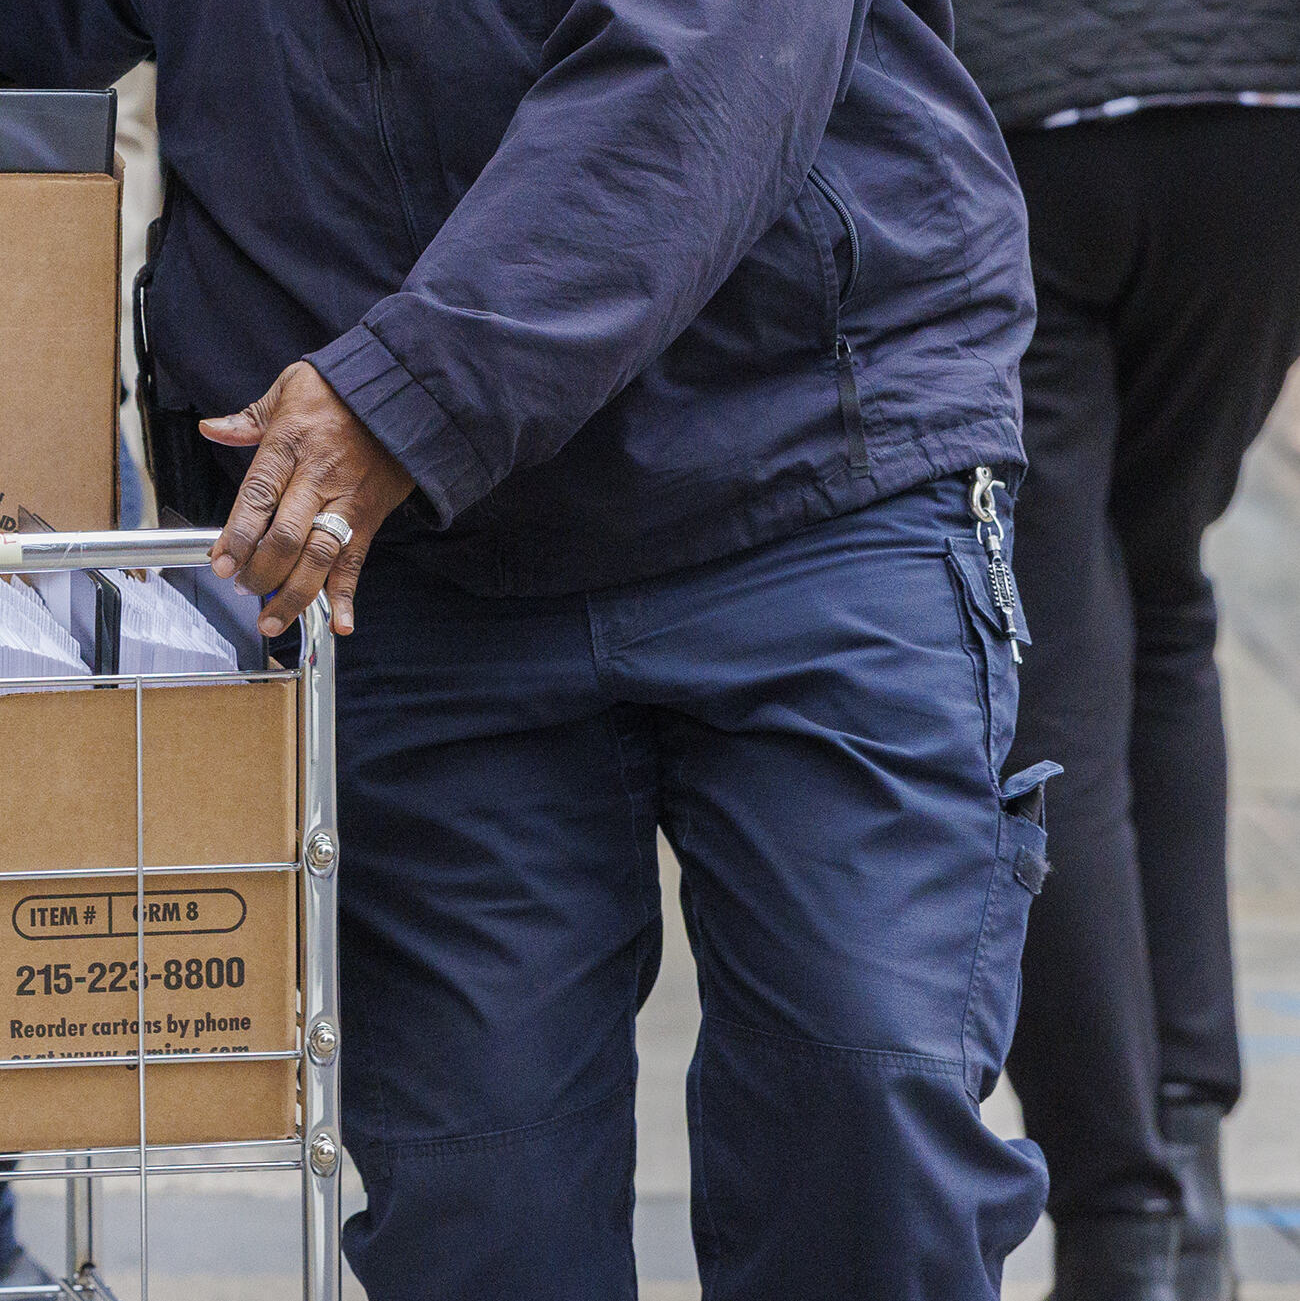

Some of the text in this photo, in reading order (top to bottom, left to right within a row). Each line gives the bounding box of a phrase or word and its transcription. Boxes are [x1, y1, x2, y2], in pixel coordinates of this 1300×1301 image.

[29, 901, 200, 927] ITEM # GRM 8
[15, 956, 246, 996] 215-223-8800
[10, 1012, 252, 1039] Reorder cartons by phone
